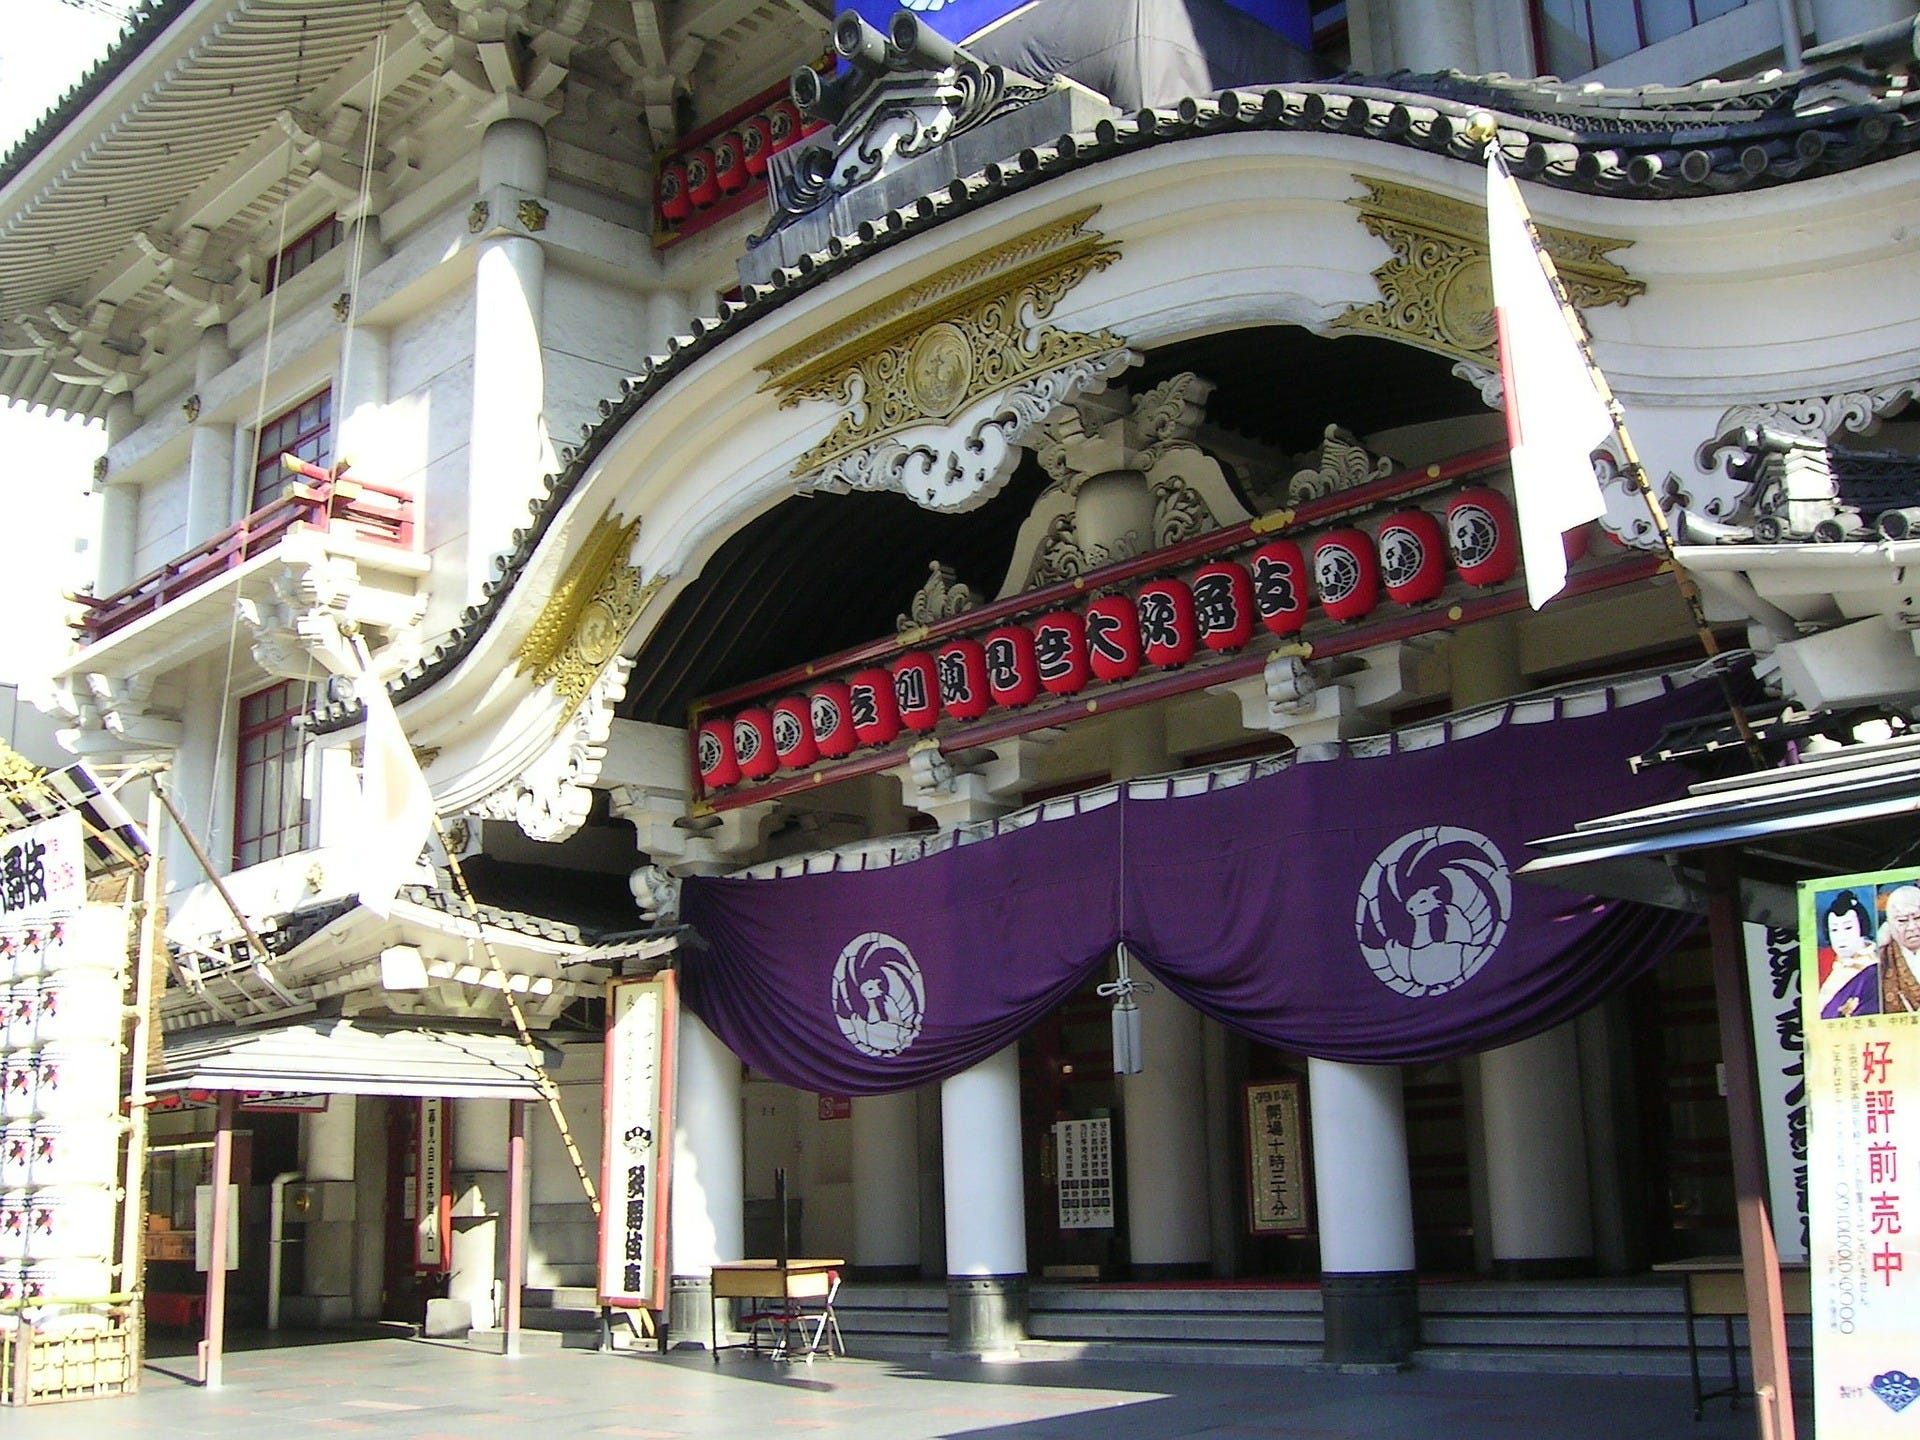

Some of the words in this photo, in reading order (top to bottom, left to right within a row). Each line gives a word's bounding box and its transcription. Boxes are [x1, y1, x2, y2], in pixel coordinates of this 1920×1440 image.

[1862, 1041, 1903, 1287] 好評前売中
